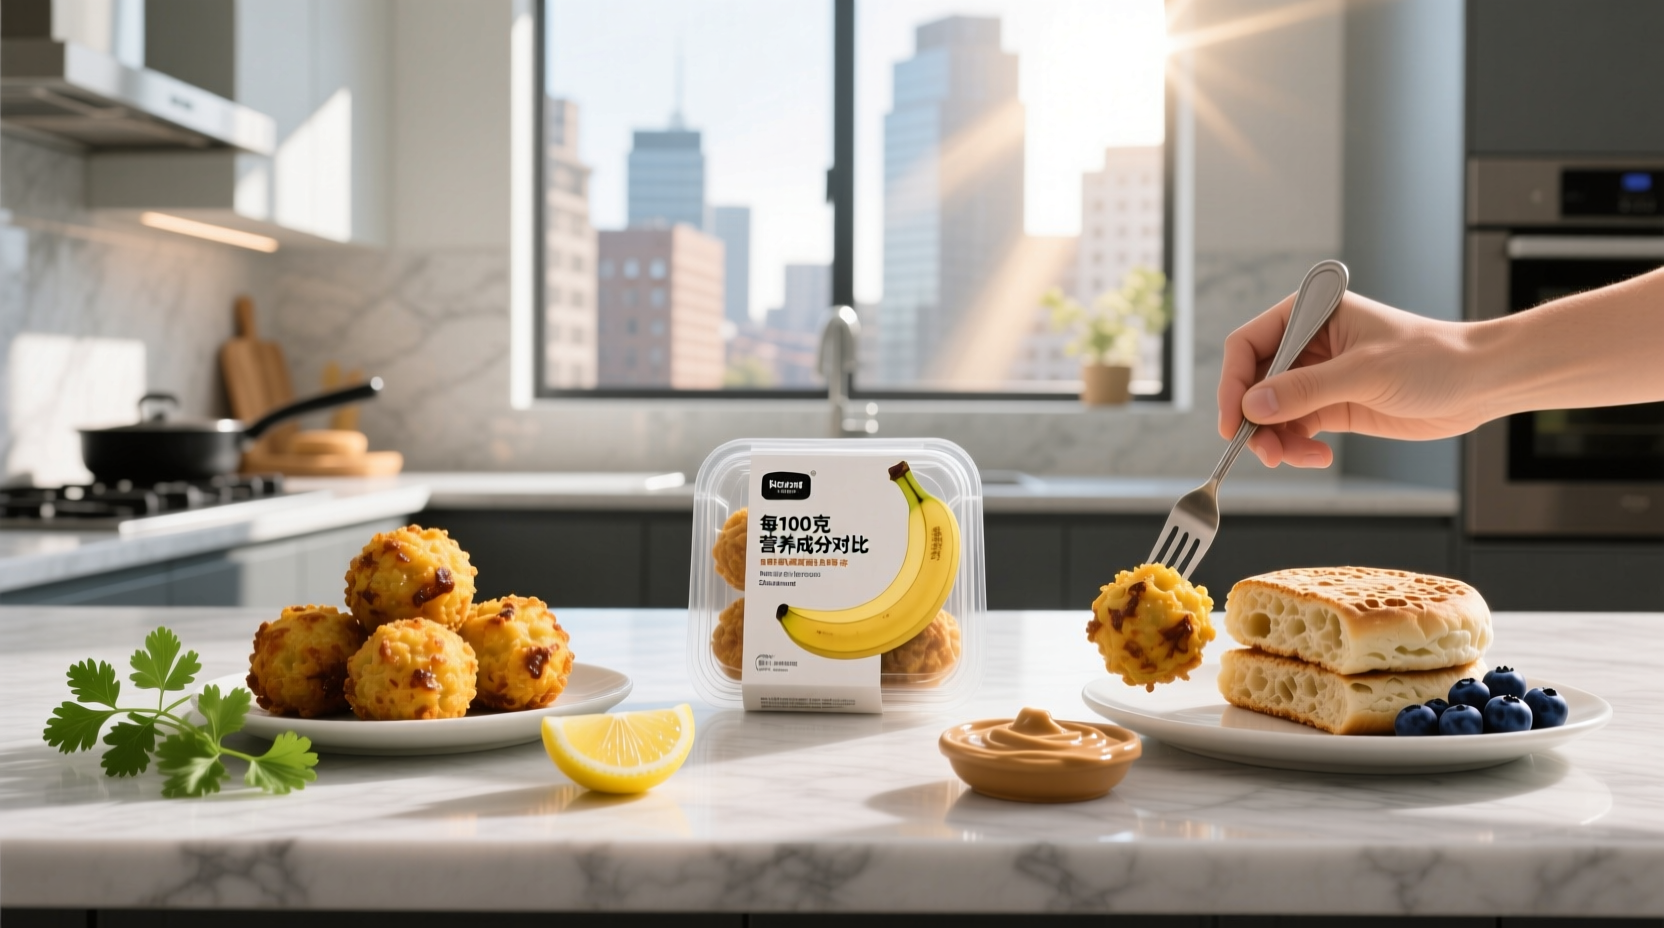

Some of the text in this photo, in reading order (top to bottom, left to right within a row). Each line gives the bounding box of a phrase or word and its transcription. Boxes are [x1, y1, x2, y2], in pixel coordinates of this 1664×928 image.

[759, 534, 869, 555] 营养成分对比
